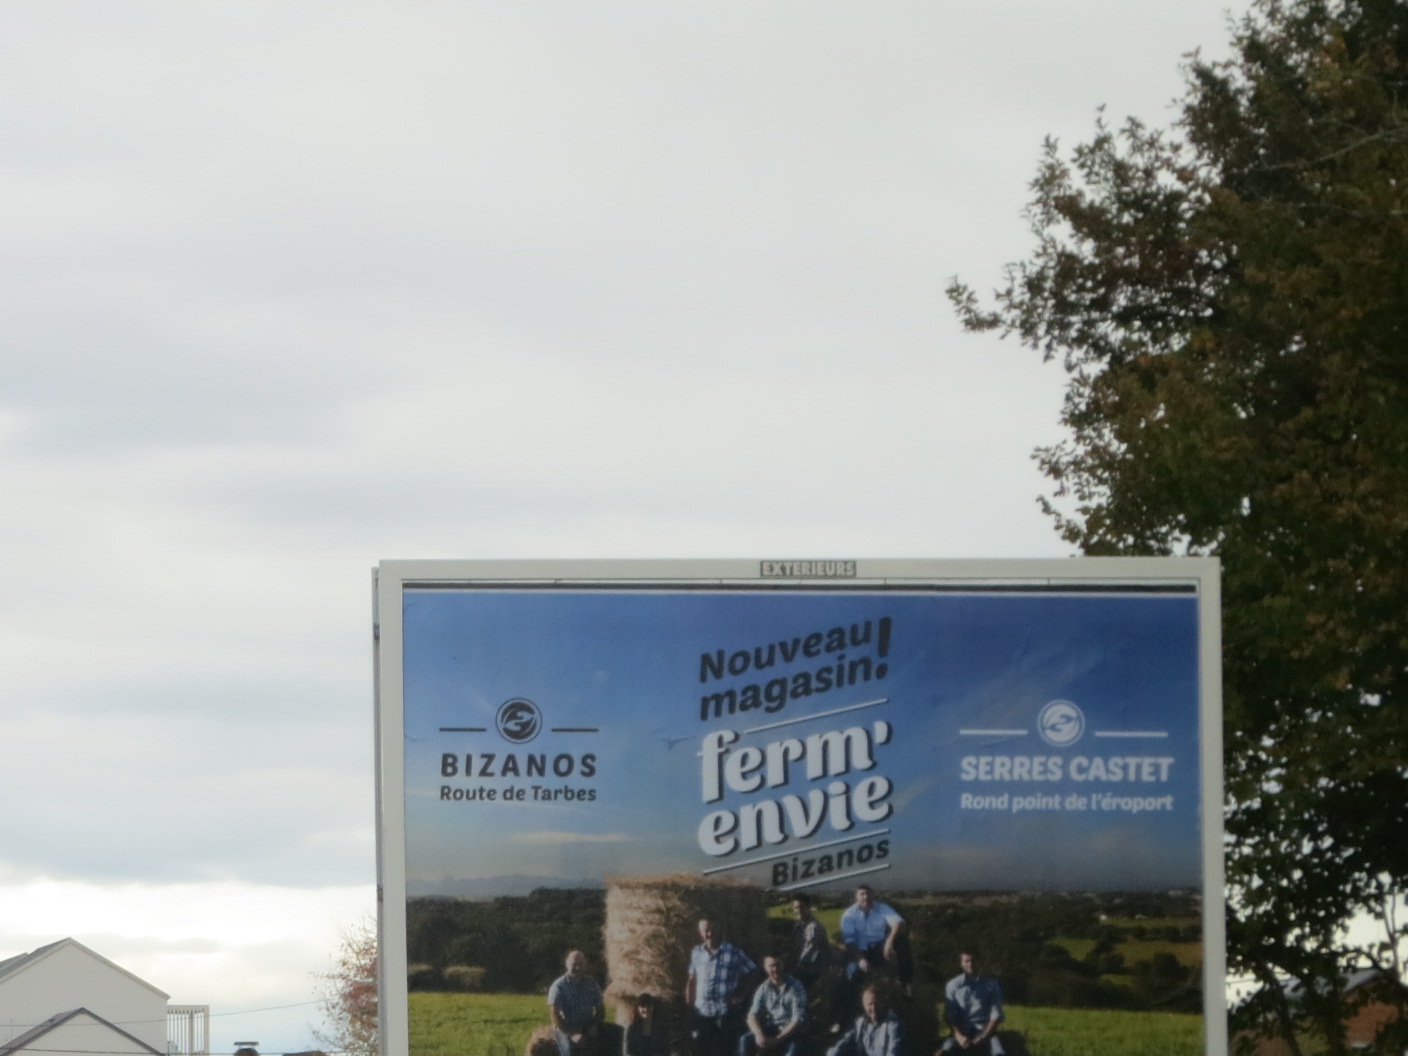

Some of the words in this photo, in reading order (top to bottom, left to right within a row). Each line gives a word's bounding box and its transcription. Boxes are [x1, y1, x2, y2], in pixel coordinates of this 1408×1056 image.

[761, 561, 855, 577] EXTERIEURS
[699, 620, 872, 683] Nouveau
[441, 753, 597, 778] BIZANOS
[960, 756, 1063, 782] SERRES
[1069, 756, 1175, 782] CASTET
[440, 785, 497, 801] Route
[502, 785, 526, 801] de
[531, 785, 597, 802] Tarbes
[961, 793, 1009, 810] Rond
[1012, 793, 1062, 813] point
[1065, 793, 1088, 810] de
[1092, 793, 1175, 814] l'éroport
[698, 775, 893, 857] envie
[771, 839, 890, 887] Bizanos
